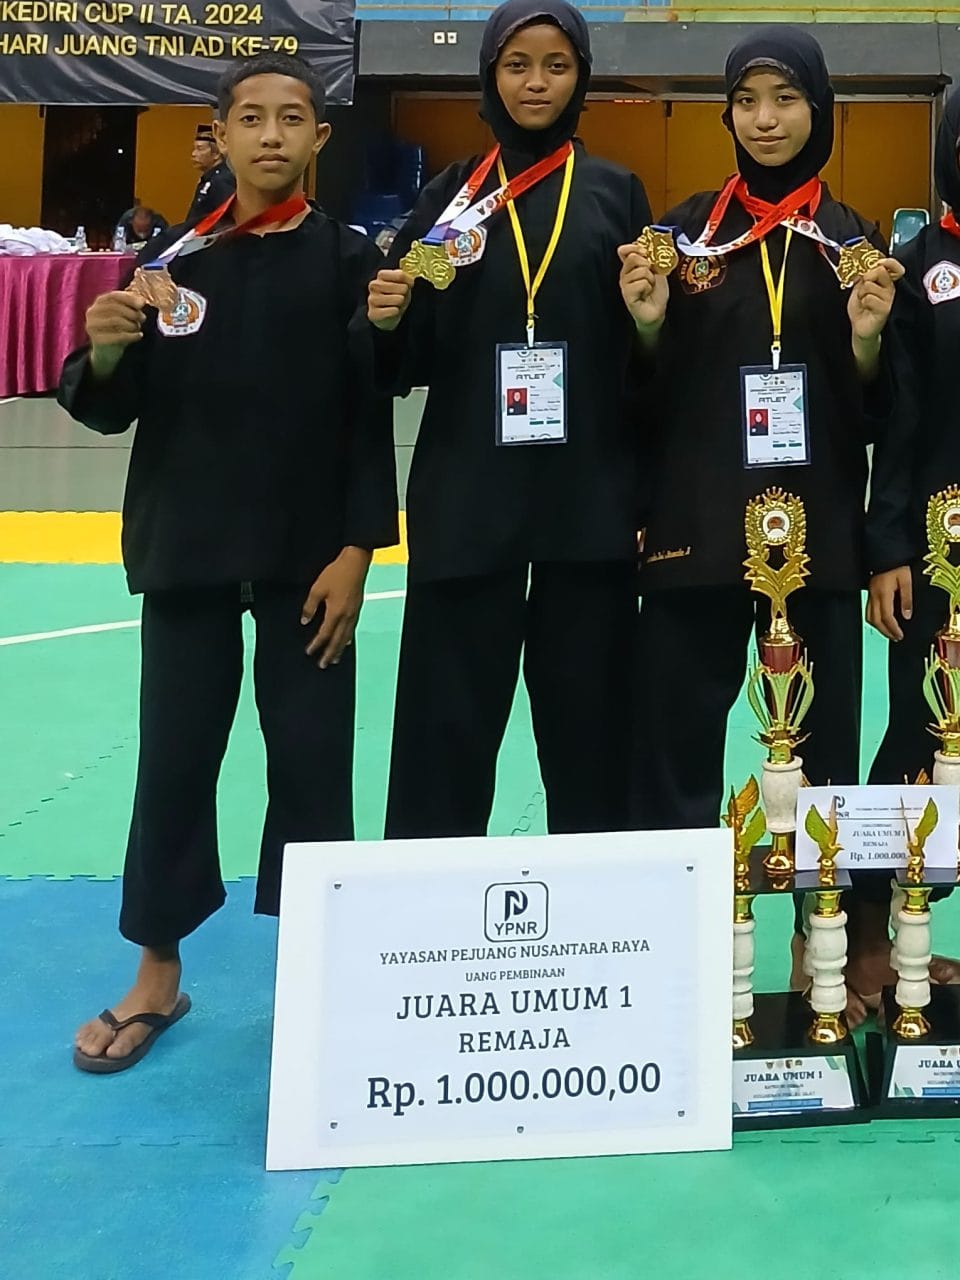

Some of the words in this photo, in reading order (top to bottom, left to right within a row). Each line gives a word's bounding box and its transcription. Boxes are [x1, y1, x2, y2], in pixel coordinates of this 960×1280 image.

[84, 3, 133, 24] CUP
[140, 4, 153, 24] II
[161, 5, 197, 25] TA.
[204, 5, 263, 25] 2024
[0, 33, 49, 55] HARI
[54, 34, 137, 56] JUANG
[144, 36, 184, 56] TNI
[191, 37, 224, 56] AD
[231, 36, 298, 56] KE-79
[516, 373, 546, 381] ATLET
[494, 921, 538, 936] YPNR
[379, 949, 448, 965] YAYASAN
[451, 946, 517, 961] PEJUANG
[520, 942, 609, 959] NUSANTARA
[611, 939, 650, 954] RAYA
[465, 970, 497, 982] UANG
[500, 967, 565, 981] PEMBINAAN
[396, 991, 500, 1020] JUARA
[511, 986, 609, 1014] UMUM
[619, 985, 633, 1008] 1
[458, 1027, 571, 1054] REMAJA
[918, 1059, 953, 1069] JUARA
[743, 1073, 780, 1082] JUARA
[783, 1070, 815, 1081] UMUM
[818, 1070, 823, 1079] 1
[366, 1076, 425, 1116] Rp.
[437, 1062, 661, 1105] 1.000.000,00
